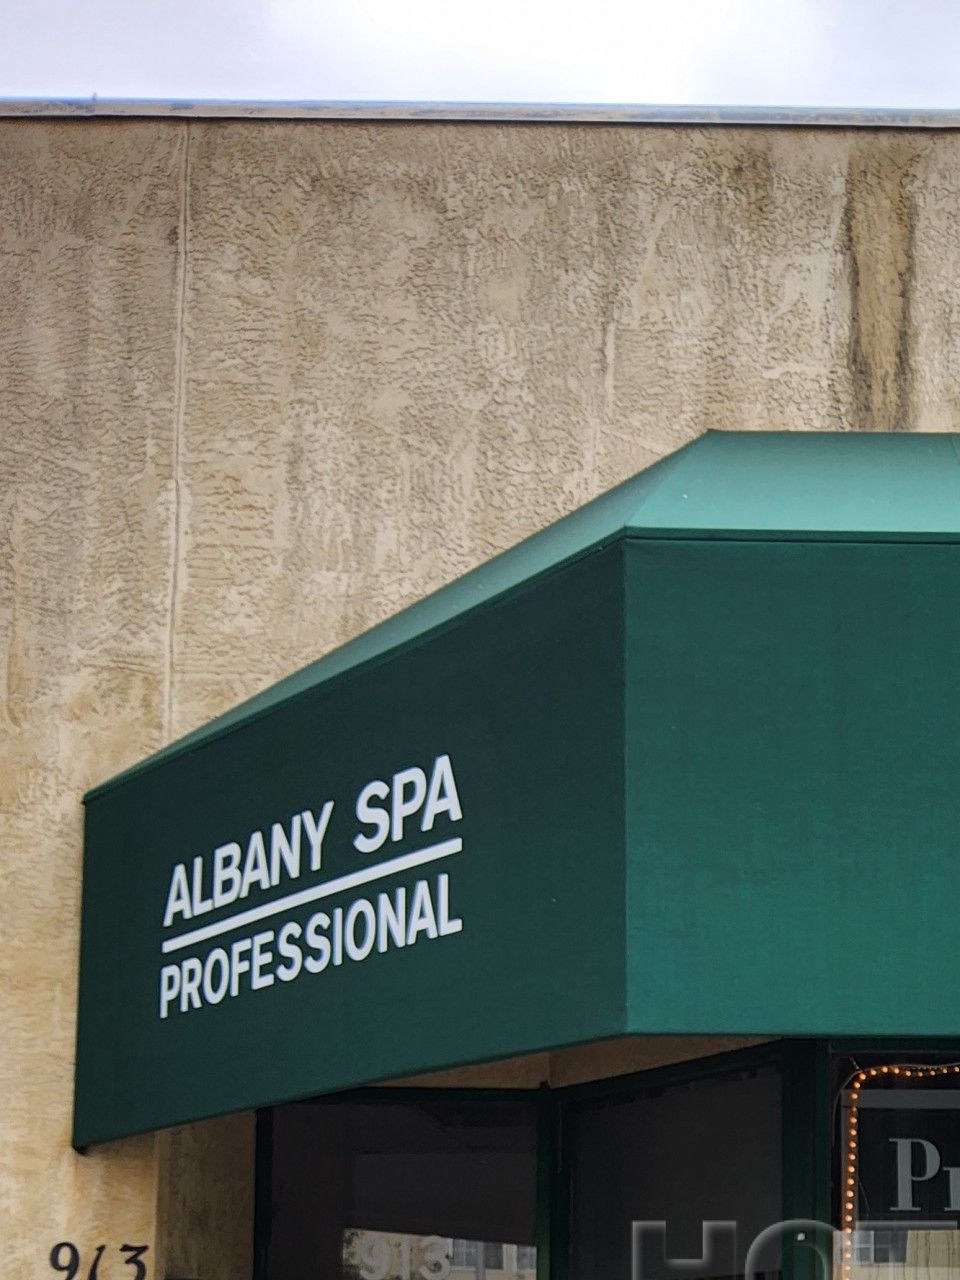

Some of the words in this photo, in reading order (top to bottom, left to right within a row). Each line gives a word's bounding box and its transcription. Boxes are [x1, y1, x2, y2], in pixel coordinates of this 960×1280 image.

[163, 800, 335, 928] ALBANY
[353, 754, 463, 853] SPA
[160, 873, 463, 1019] PROFESSIONAL
